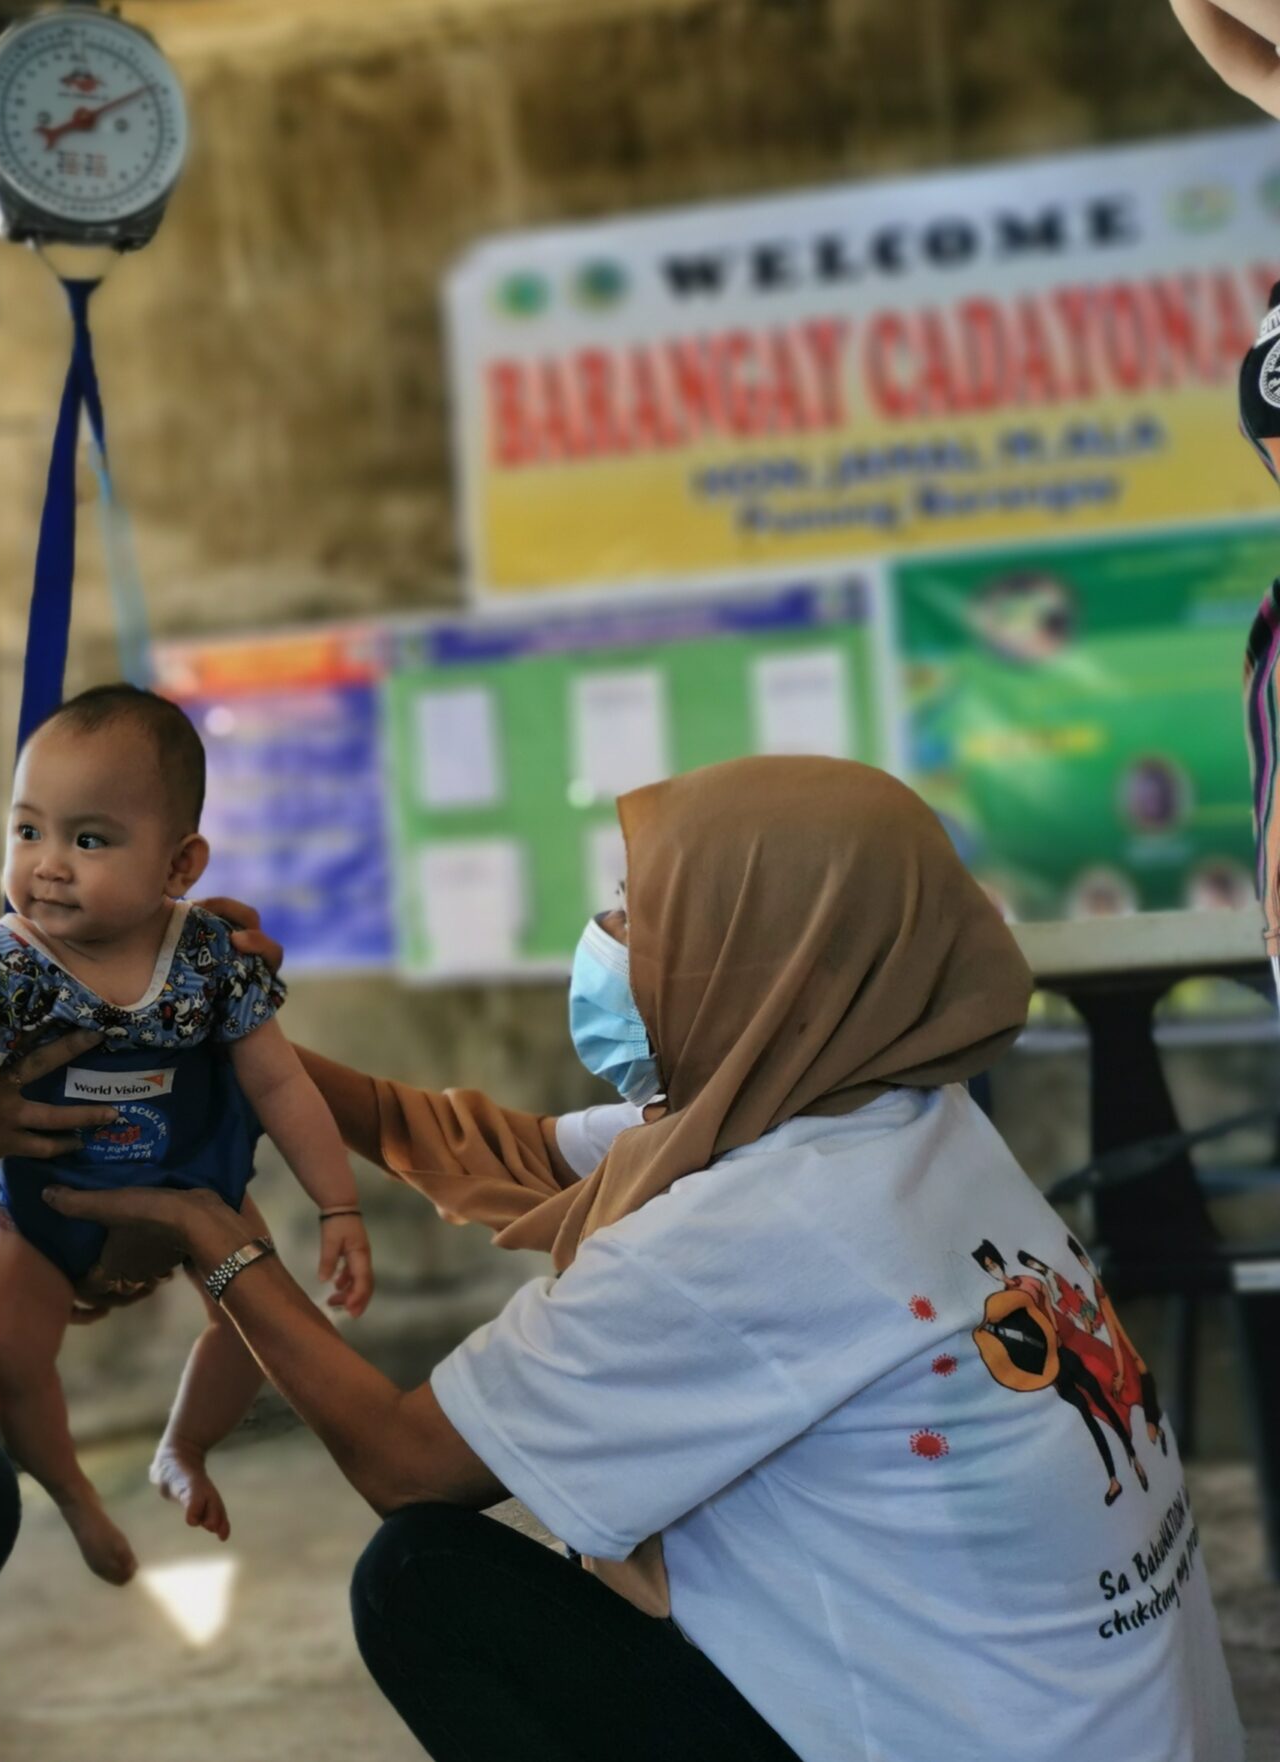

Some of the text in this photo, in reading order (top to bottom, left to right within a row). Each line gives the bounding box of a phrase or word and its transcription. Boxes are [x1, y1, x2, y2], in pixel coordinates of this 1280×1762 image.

[661, 197, 1140, 304] WELCOME
[484, 314, 851, 470] BARANGAY
[74, 1082, 151, 1096] World Vision
[1098, 1487, 1187, 1601] Sa BakuNATION
[1097, 1578, 1181, 1639] chikiting
